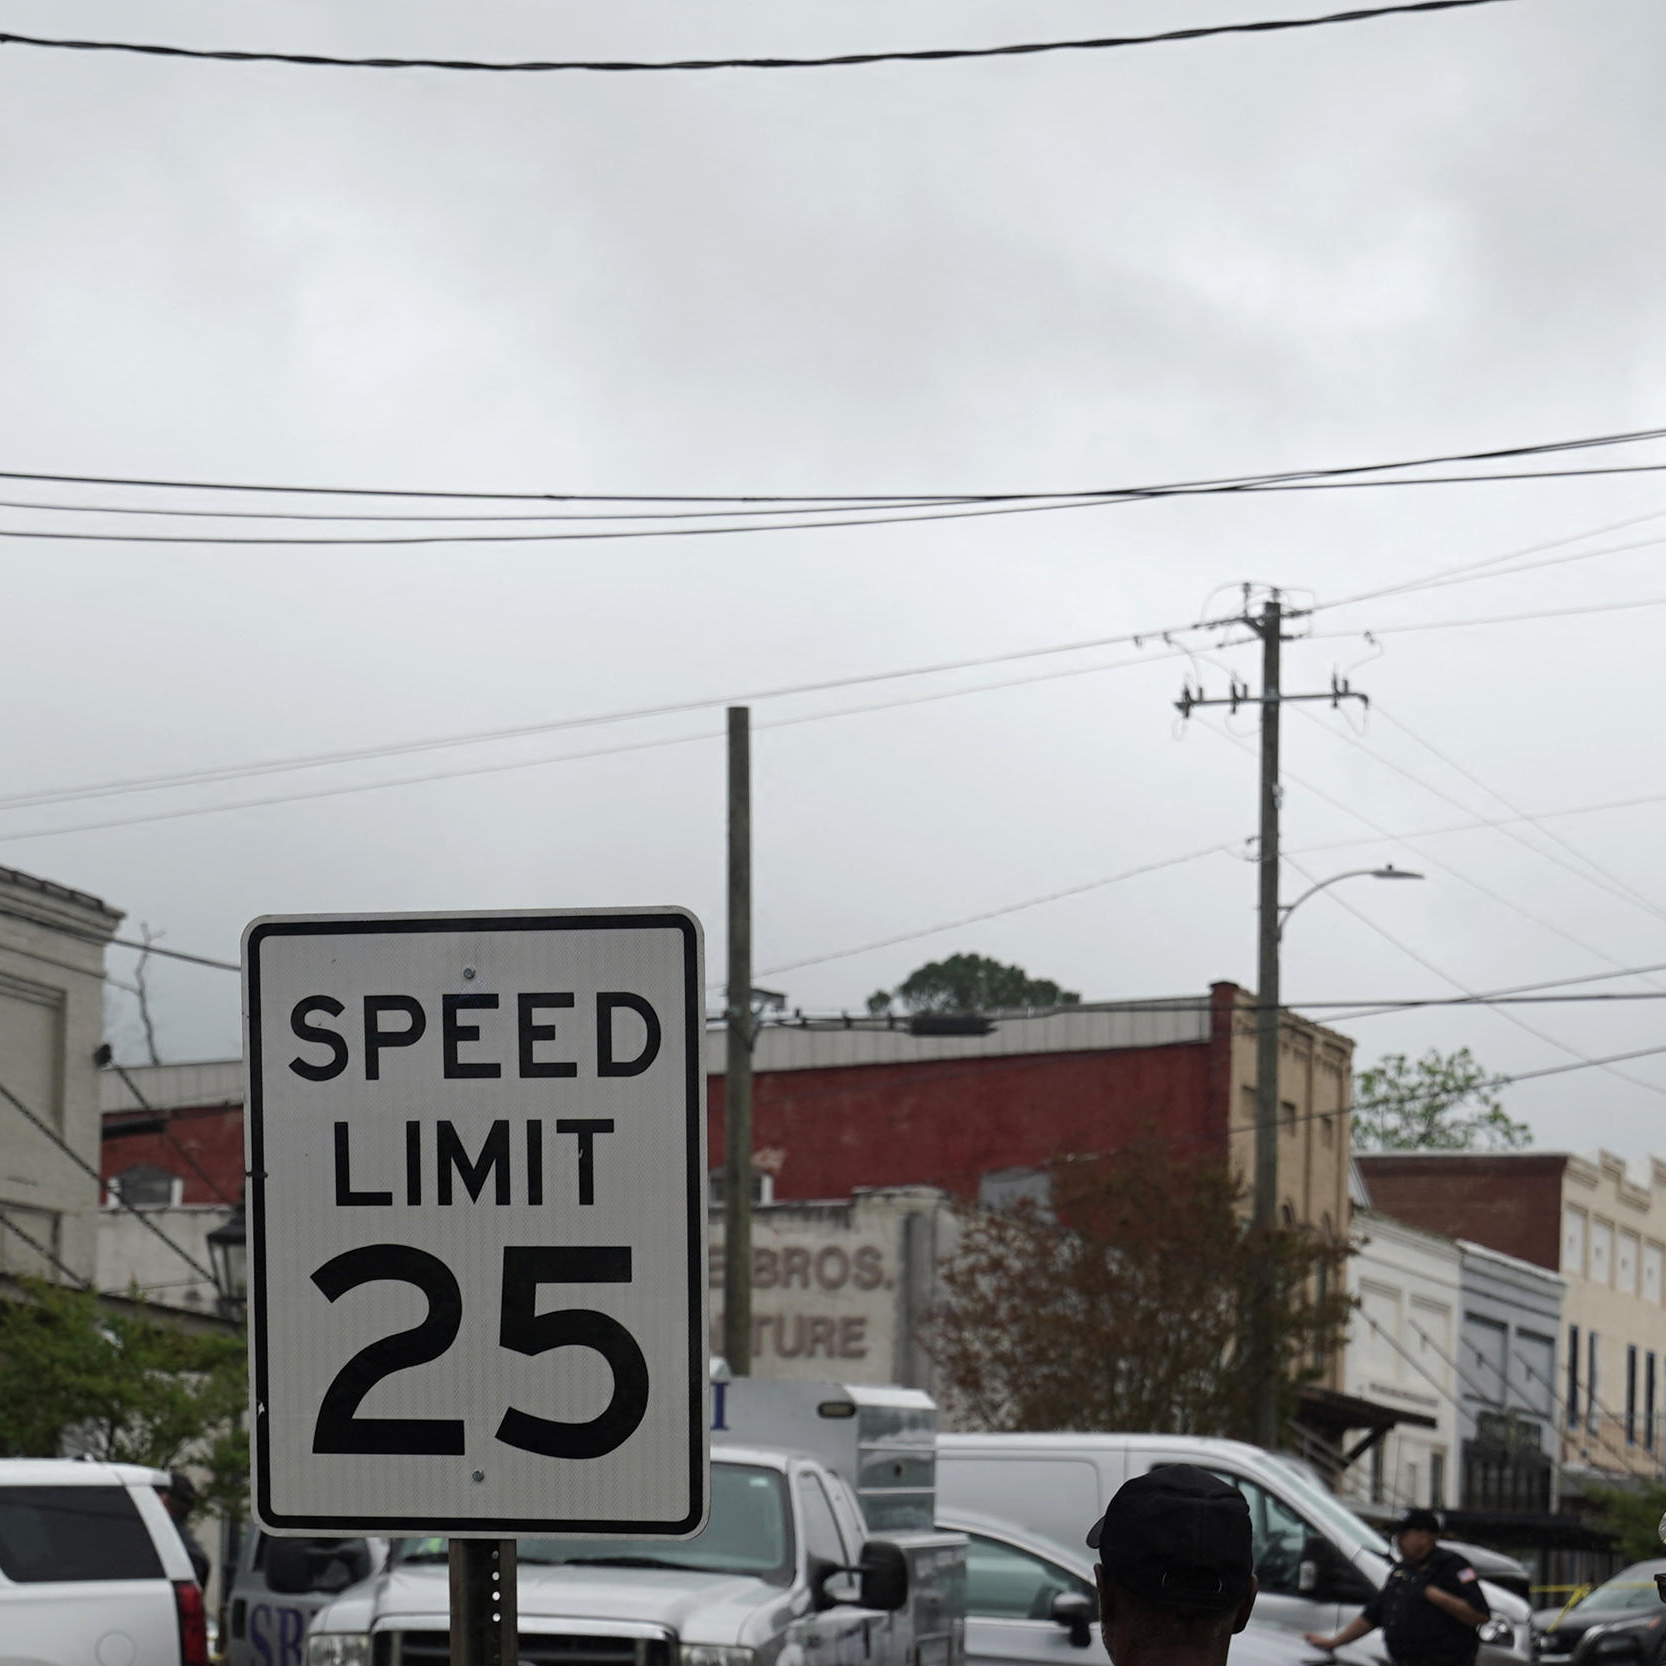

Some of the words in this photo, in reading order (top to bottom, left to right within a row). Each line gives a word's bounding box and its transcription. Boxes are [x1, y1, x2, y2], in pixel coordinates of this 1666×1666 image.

[288, 991, 662, 1081] SPEED
[334, 1119, 614, 1206] LIMIT
[310, 1243, 650, 1460] 25
[713, 1312, 869, 1359] TURE
